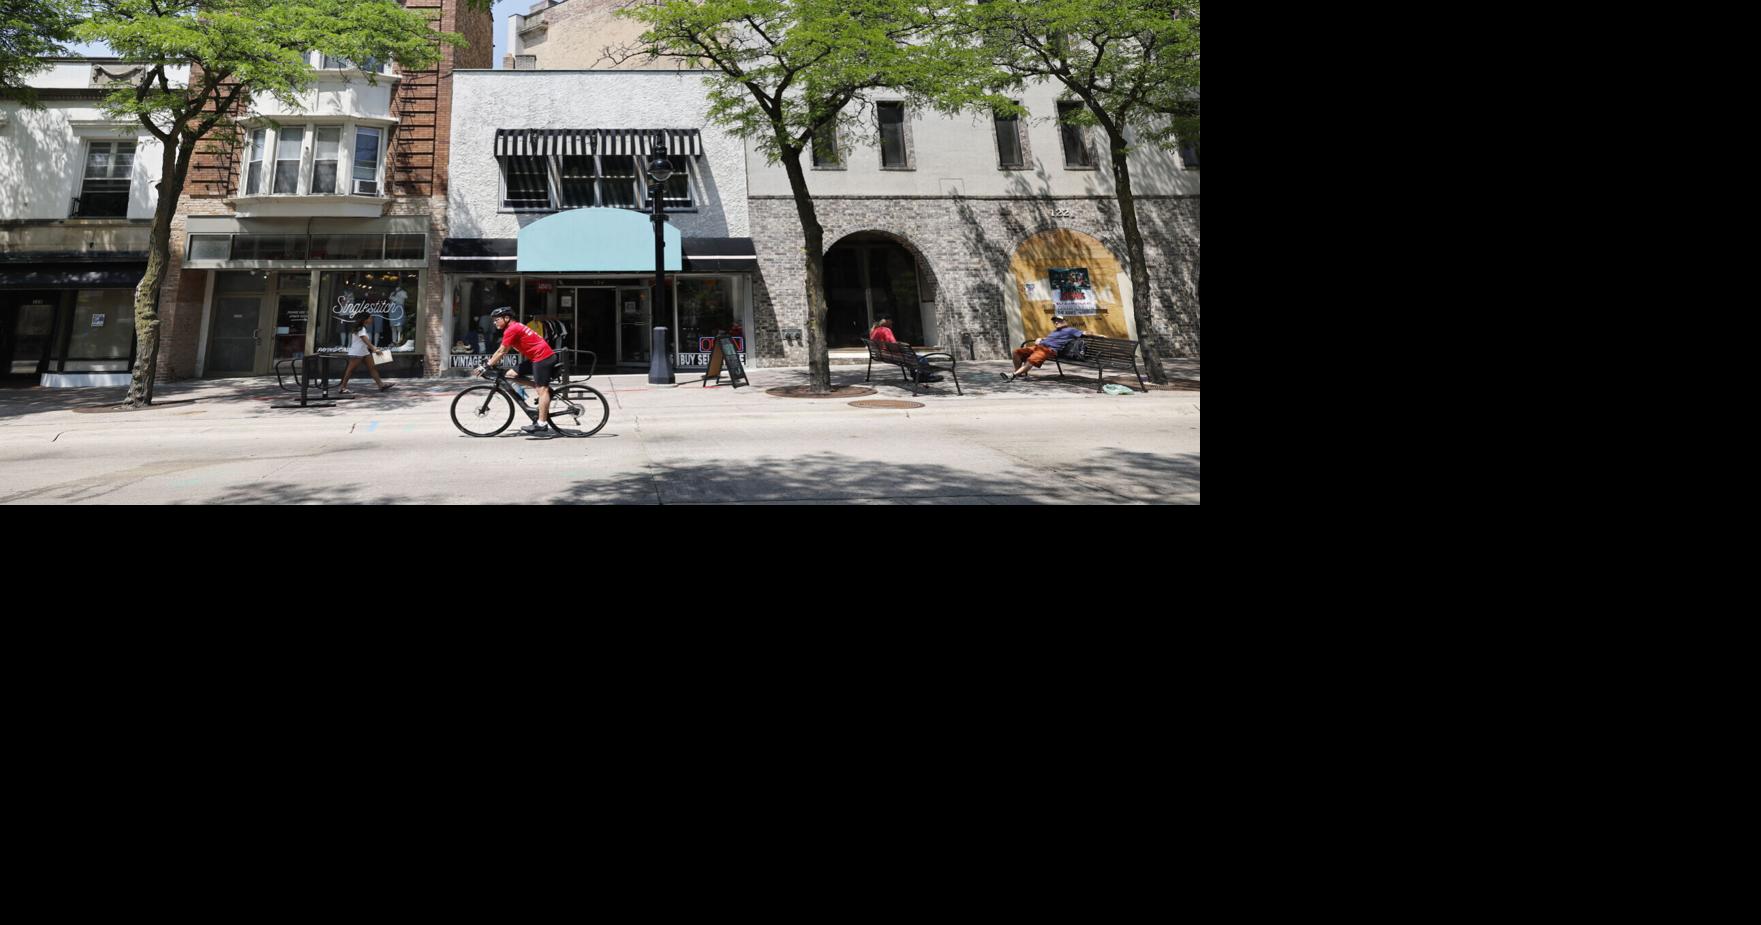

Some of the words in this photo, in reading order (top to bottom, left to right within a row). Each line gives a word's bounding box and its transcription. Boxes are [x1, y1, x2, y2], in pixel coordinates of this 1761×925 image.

[332, 295, 404, 319] Singlestitch
[701, 338, 743, 351] ON
[453, 355, 482, 368] VINTAGE
[680, 354, 696, 365] BUY
